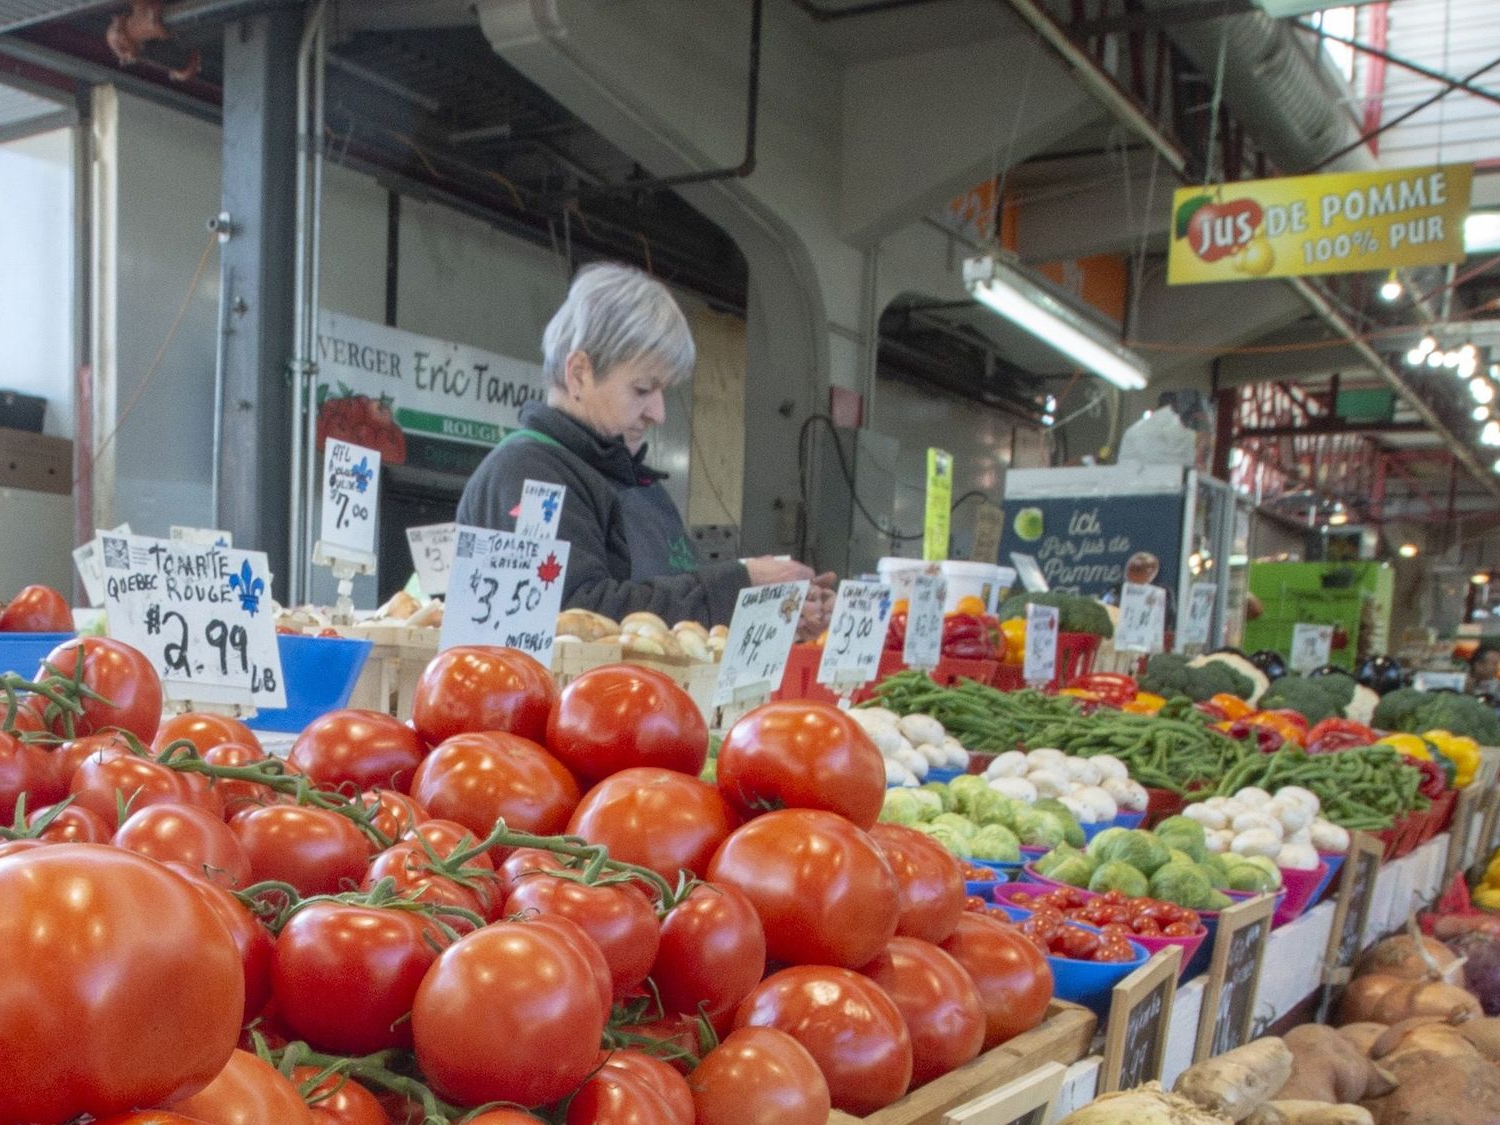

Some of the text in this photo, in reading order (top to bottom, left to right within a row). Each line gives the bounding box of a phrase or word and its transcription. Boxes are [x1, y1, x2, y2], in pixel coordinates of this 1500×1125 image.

[1266, 202, 1308, 238] DE
[1320, 172, 1447, 227] POMME
[1303, 215, 1445, 264] 100% PUR
[317, 335, 402, 379] VERGER
[414, 352, 470, 397] Eric
[107, 572, 233, 604] QUEBEC ROUGE
[149, 544, 231, 579] TOMATE
[144, 604, 276, 694] $2.99 LB
